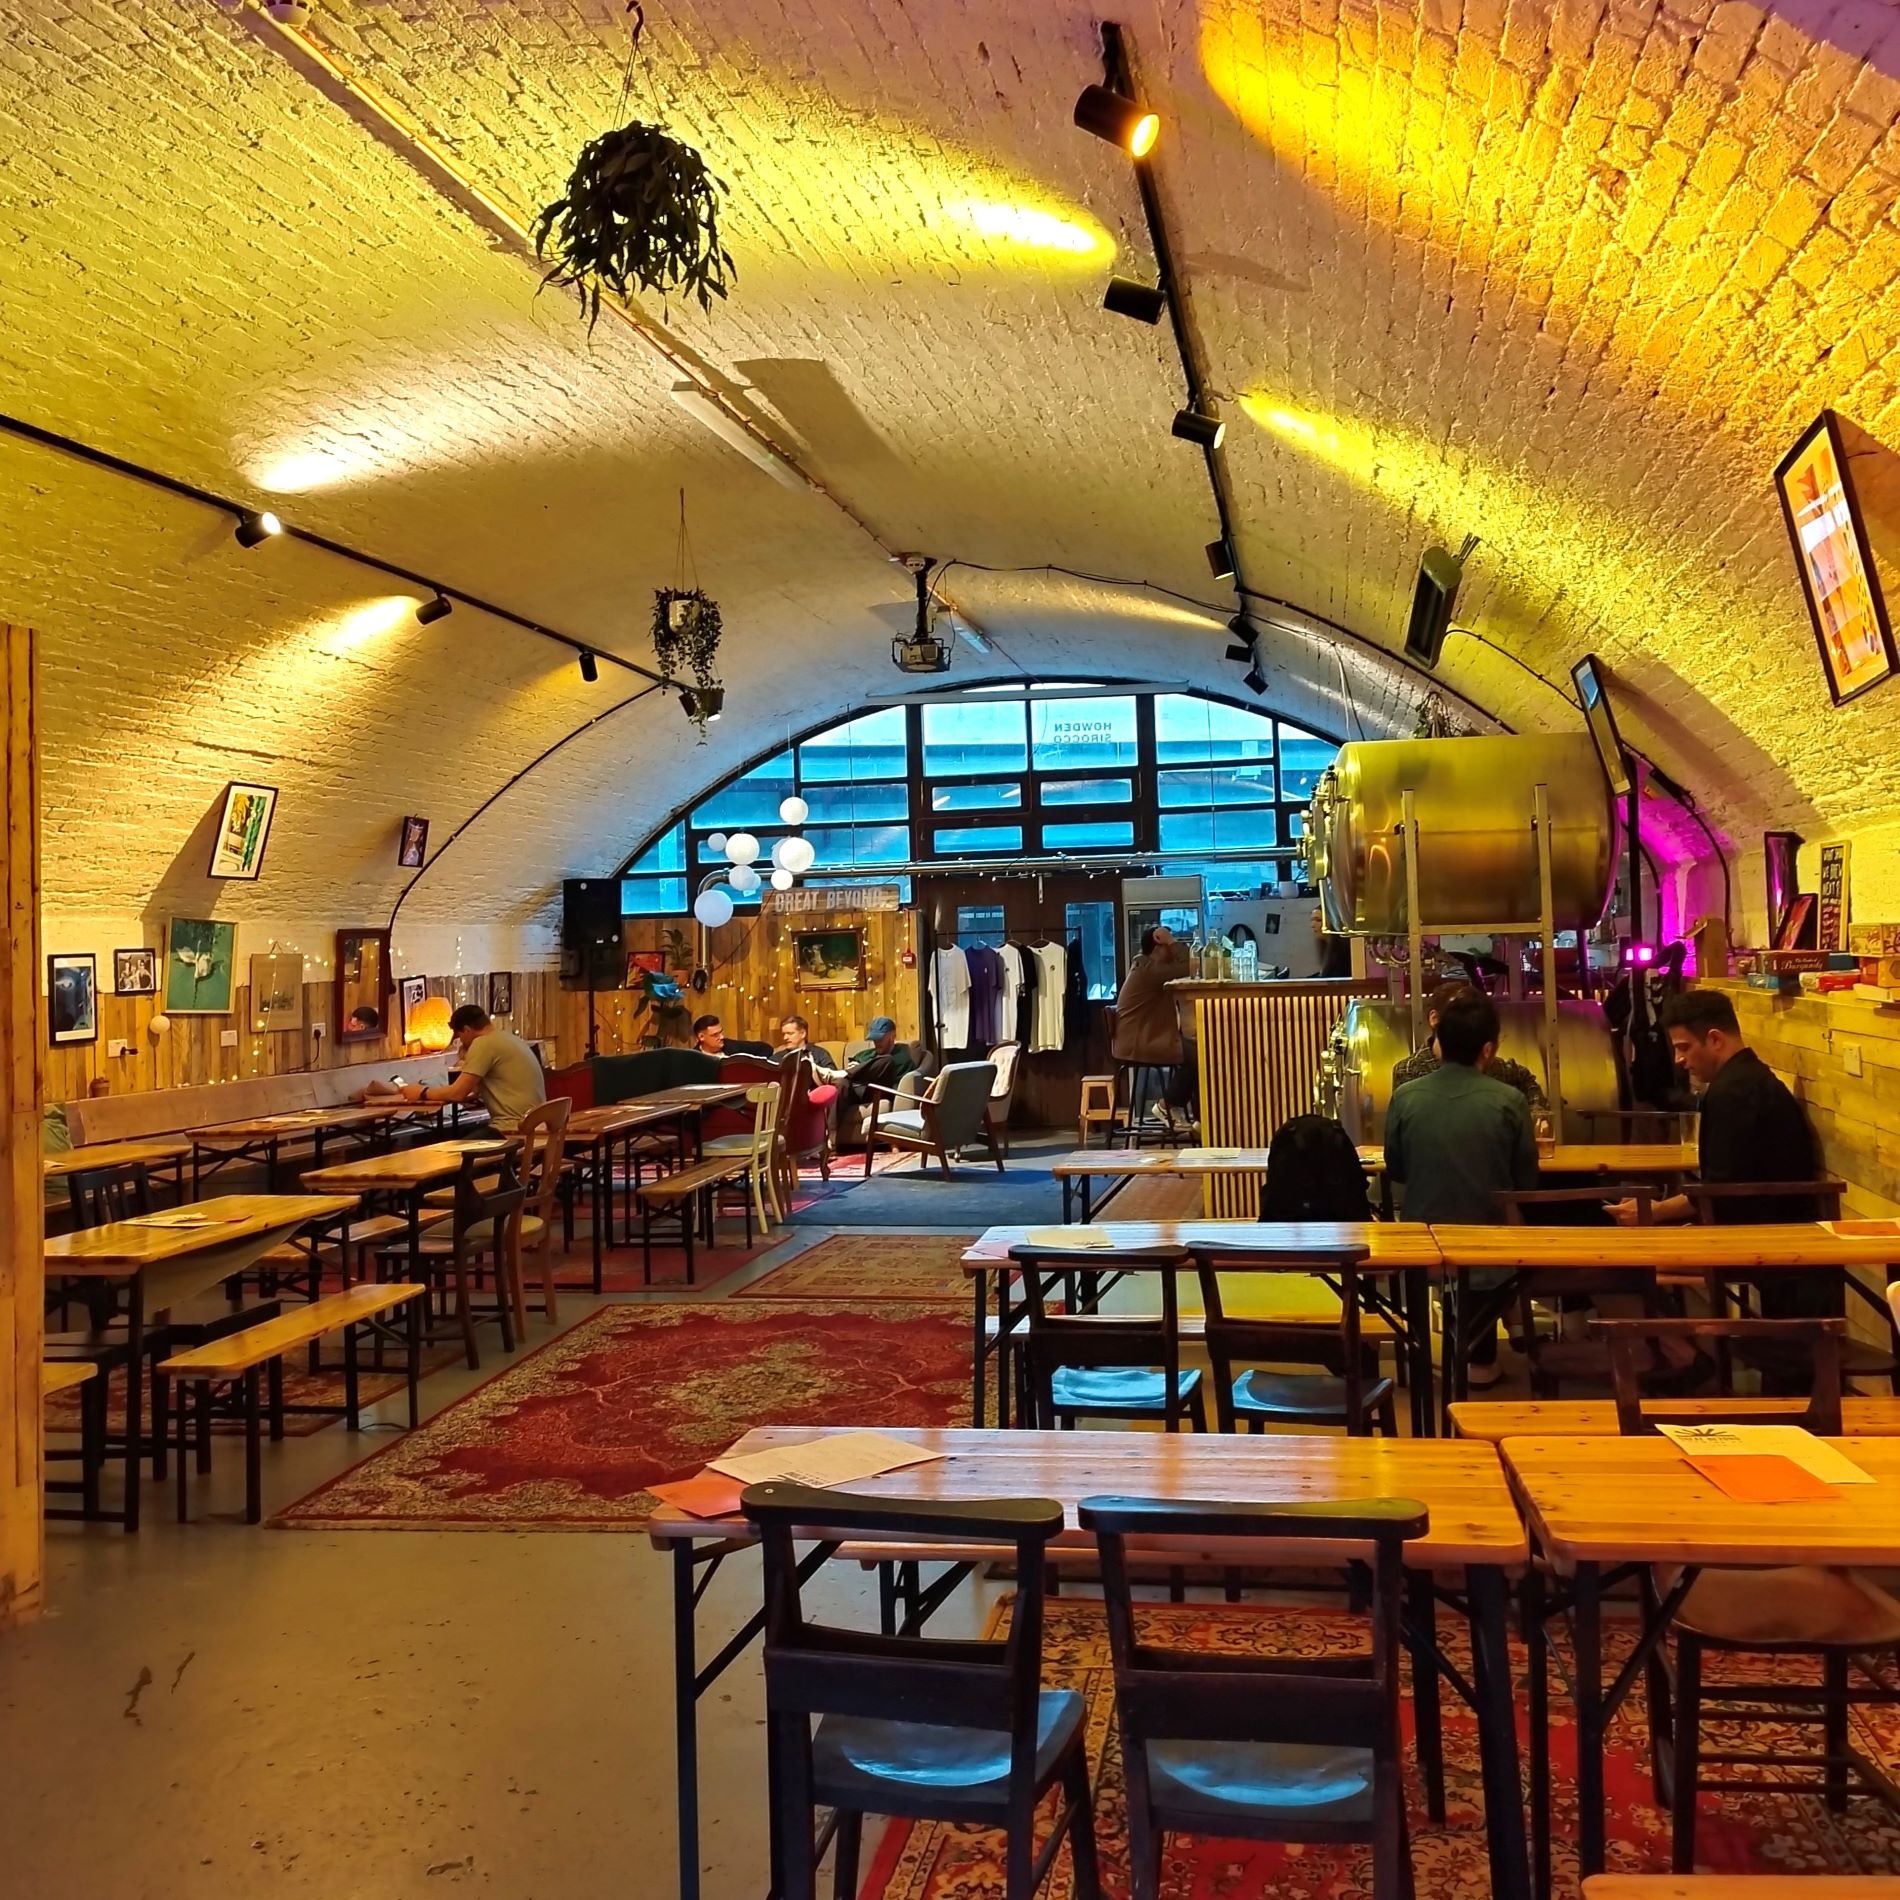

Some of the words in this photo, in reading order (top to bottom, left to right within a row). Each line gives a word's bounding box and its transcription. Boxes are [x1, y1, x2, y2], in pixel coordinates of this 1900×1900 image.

[775, 891, 819, 912] GREAT
[826, 886, 883, 909] BEYOND
[1781, 959, 1823, 971] Burgundy
